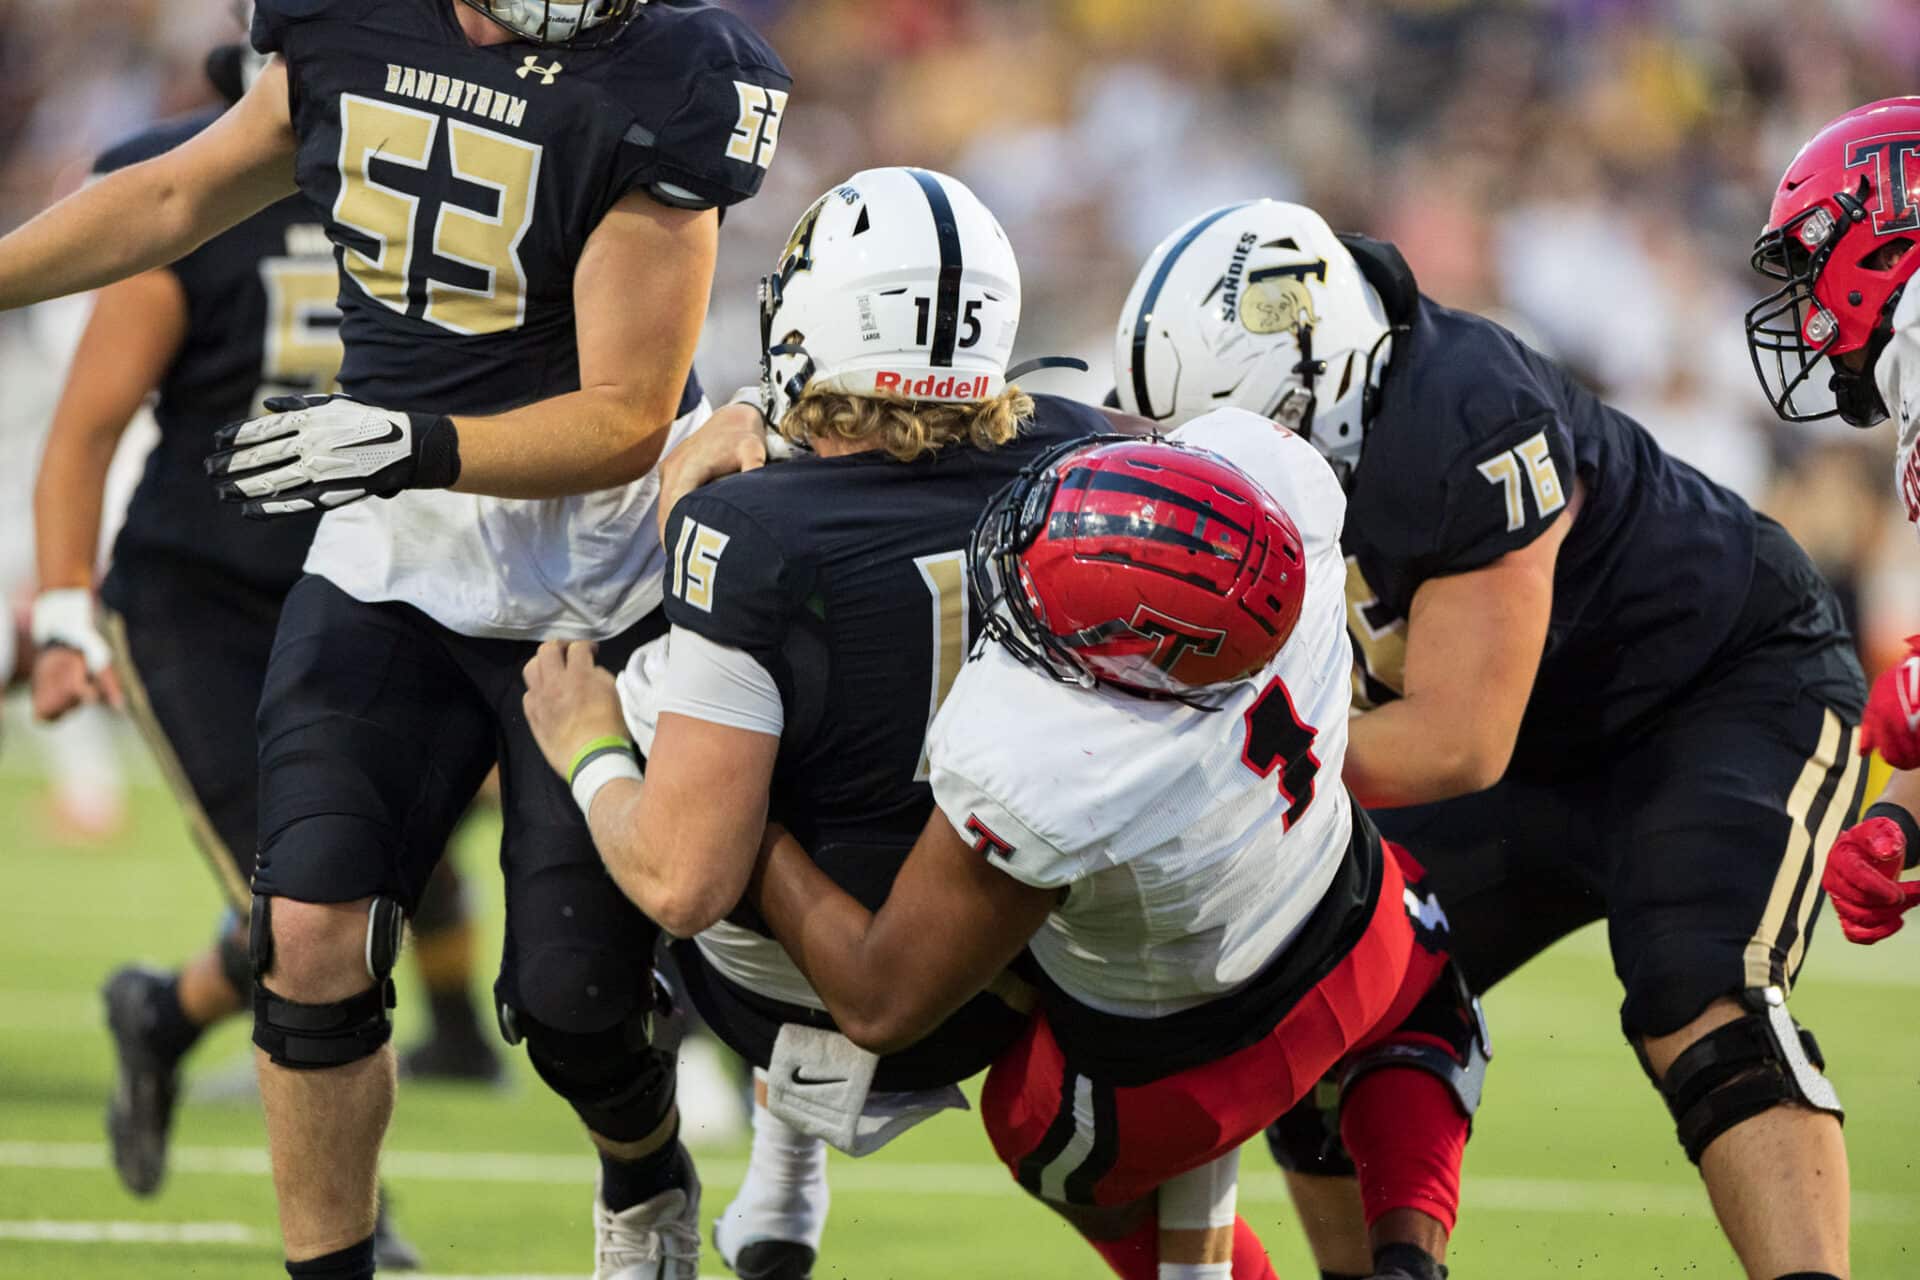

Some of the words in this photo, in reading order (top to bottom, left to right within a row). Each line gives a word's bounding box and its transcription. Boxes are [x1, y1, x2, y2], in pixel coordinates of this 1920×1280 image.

[384, 63, 528, 128] SANDSTORM
[725, 80, 789, 170] 53
[333, 92, 543, 336] 53
[1222, 231, 1258, 323] SANDIES
[875, 371, 989, 399] Riddell
[1476, 432, 1566, 532] 76
[672, 515, 731, 613] 15
[913, 549, 1000, 783] 1
[1120, 603, 1227, 688] T
[1240, 674, 1322, 834] 1
[964, 812, 1016, 862] T
